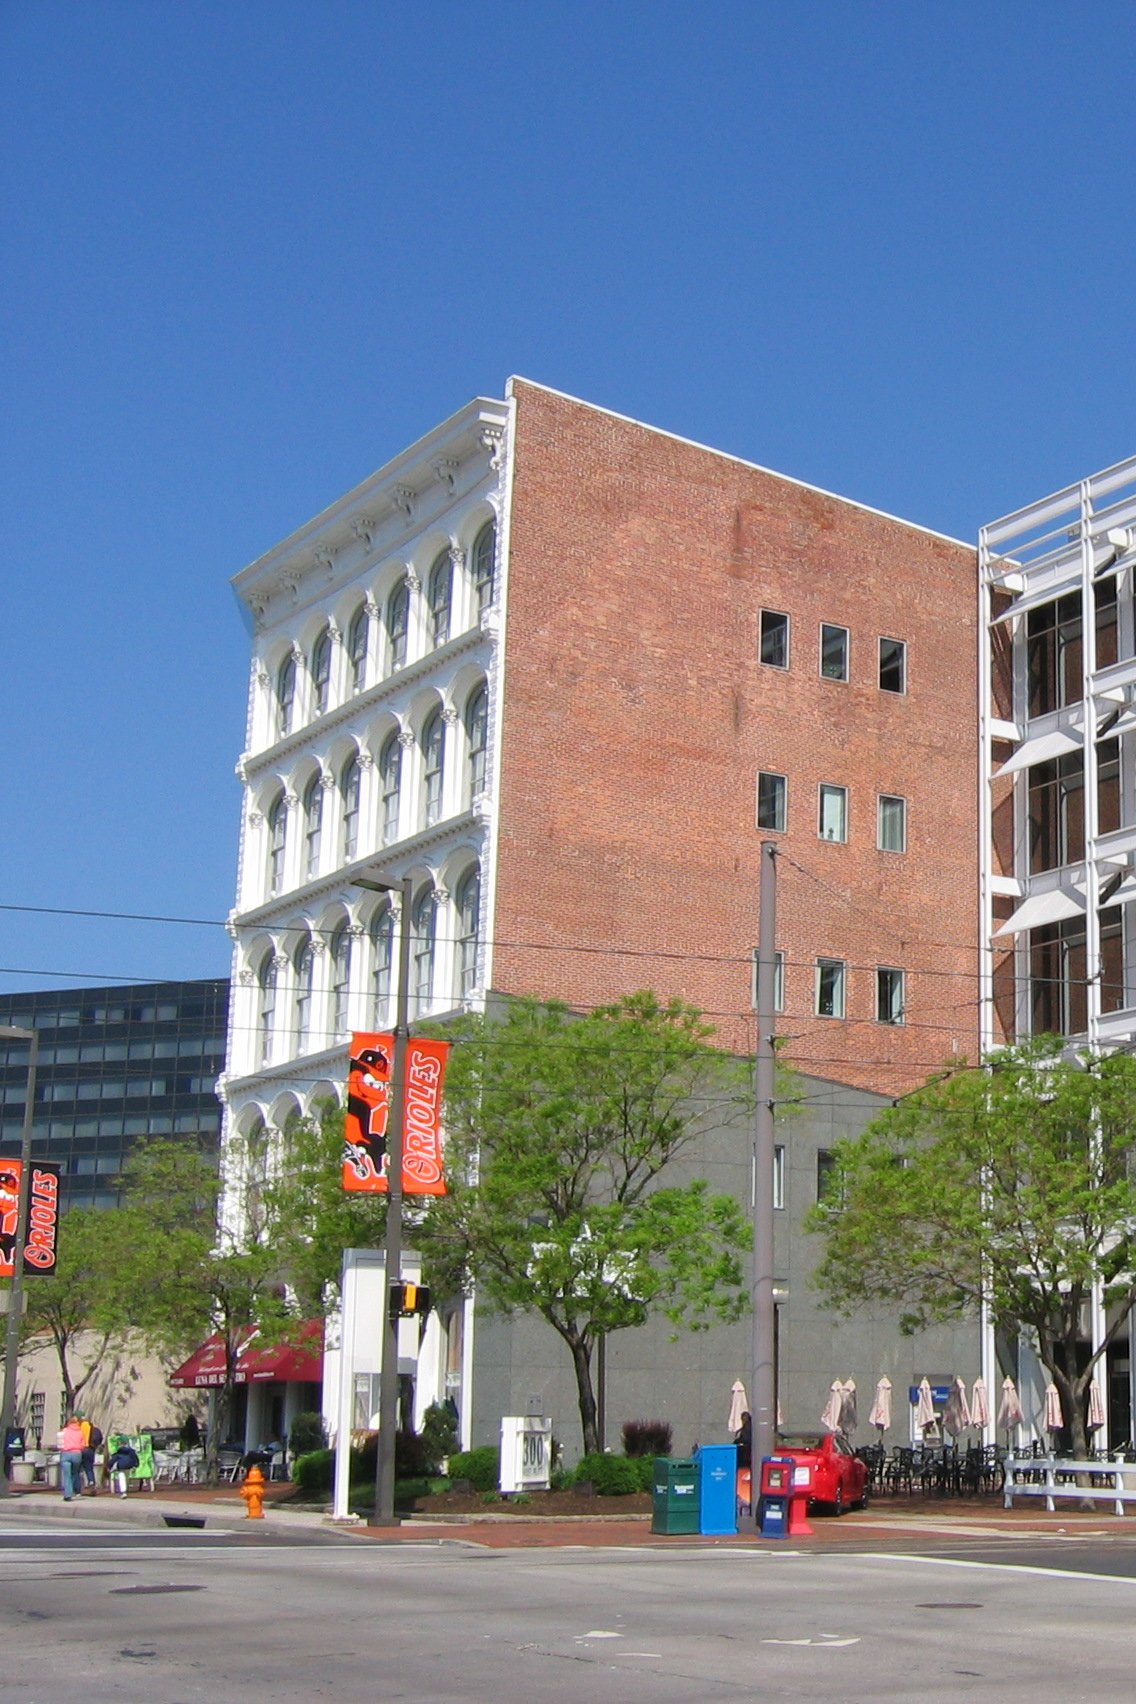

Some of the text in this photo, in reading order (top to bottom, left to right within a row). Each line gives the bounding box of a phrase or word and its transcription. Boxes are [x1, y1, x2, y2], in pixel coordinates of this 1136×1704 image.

[403, 1051, 441, 1183] ORIOLES
[23, 1169, 58, 1268] ORIOLES
[523, 1434, 543, 1467] 300
